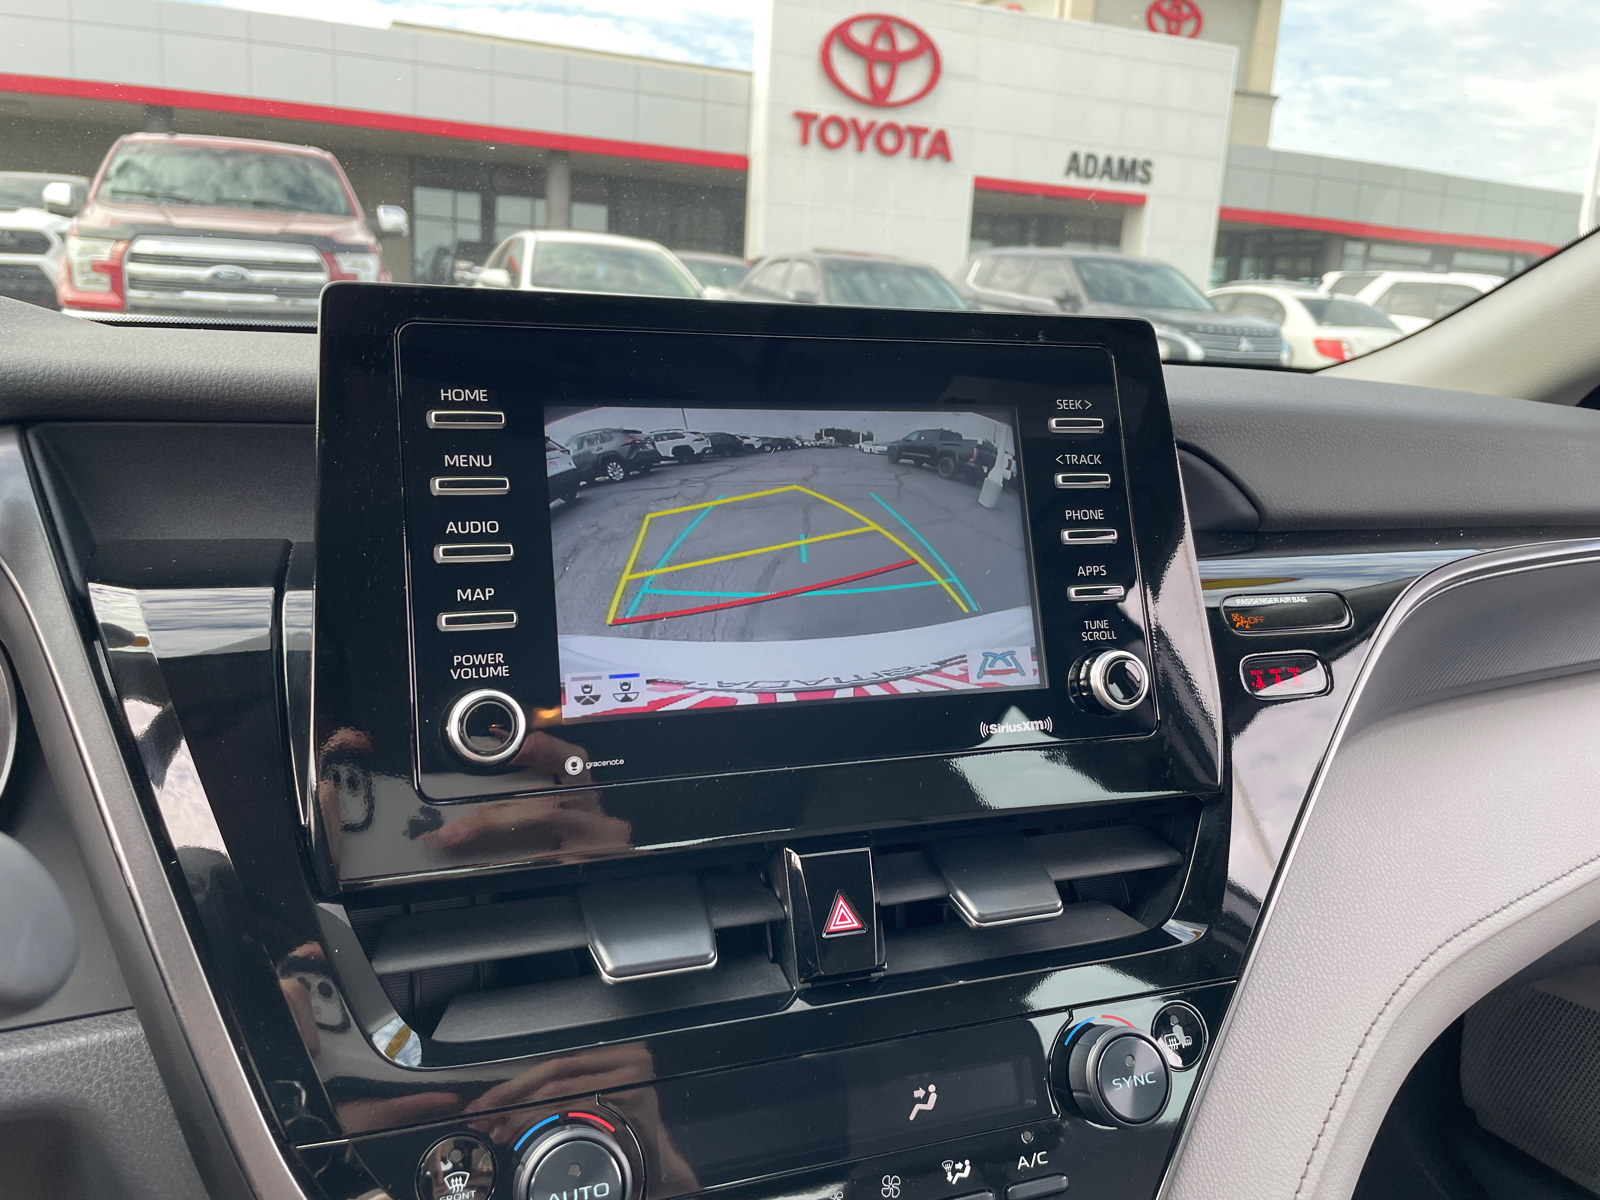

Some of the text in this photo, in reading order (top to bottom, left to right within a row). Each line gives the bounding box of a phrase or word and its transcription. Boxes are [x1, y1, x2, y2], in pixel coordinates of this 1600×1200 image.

[793, 110, 953, 162] TOYOTA
[1064, 151, 1153, 184] ADAMS
[440, 388, 488, 402] HOME
[1056, 399, 1083, 411] SEEK
[444, 454, 492, 468] MENU
[1065, 453, 1102, 465] TRACK
[1065, 509, 1105, 521] PHONE
[445, 520, 500, 535] AUDIO
[1077, 565, 1107, 577] APPS
[456, 587, 495, 602] MAP
[1235, 597, 1280, 605] PASSENGER
[1084, 620, 1109, 630] TUNE
[1247, 616, 1265, 624] OFF
[1081, 630, 1117, 642] SCROLL
[453, 653, 504, 667] POWER
[450, 666, 510, 681] VOLUME
[585, 758, 625, 770] gracenote
[1112, 1071, 1156, 1091] SYNC
[1017, 1150, 1049, 1170] A/C
[549, 1182, 610, 1200] AUTO
